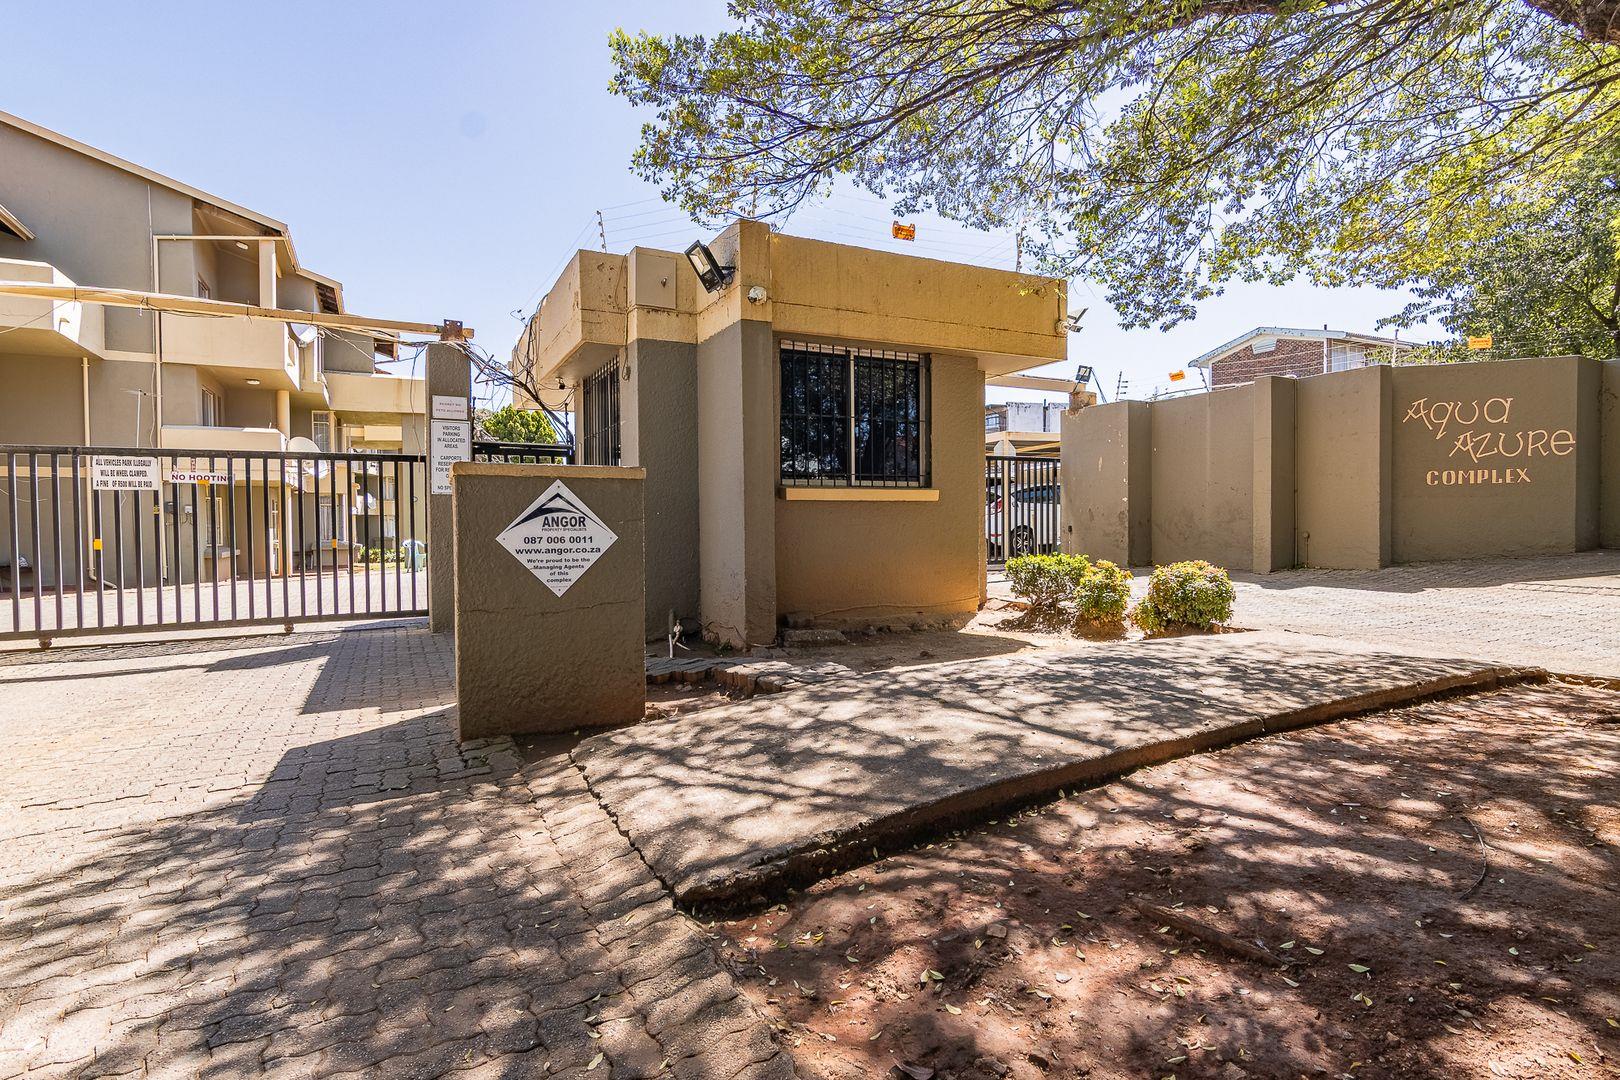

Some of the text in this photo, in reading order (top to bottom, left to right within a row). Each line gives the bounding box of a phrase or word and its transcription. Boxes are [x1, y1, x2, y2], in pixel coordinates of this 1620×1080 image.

[95, 458, 103, 466] ALL
[100, 469, 110, 477] WILL
[1426, 467, 1532, 486] COMPLEX
[189, 474, 230, 482] HOOTIN
[100, 480, 109, 488] FINE
[112, 480, 117, 488] OF
[128, 480, 137, 488] WILL
[137, 480, 143, 488] BE
[143, 480, 153, 488] PAID
[541, 516, 587, 528] ANGOR
[523, 535, 593, 545] 087 006 0011
[515, 546, 601, 555] www.angor.co.za
